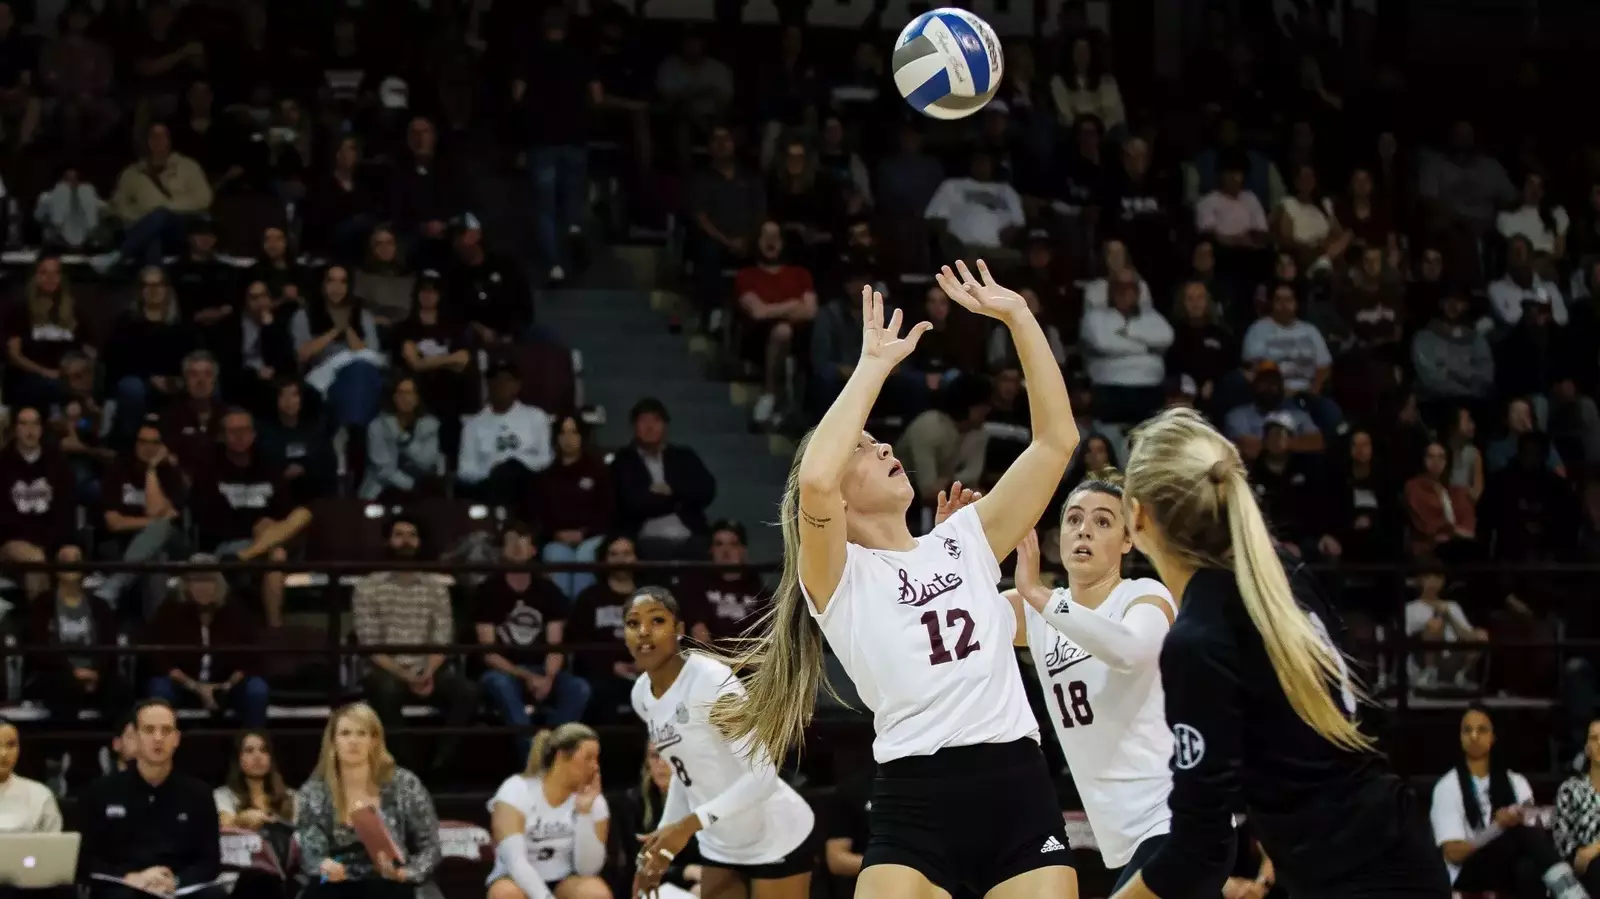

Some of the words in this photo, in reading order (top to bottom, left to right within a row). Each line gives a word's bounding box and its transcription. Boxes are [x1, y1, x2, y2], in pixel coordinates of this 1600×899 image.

[920, 608, 980, 665] 12
[1045, 635, 1090, 673] Sta
[1053, 680, 1094, 728] 18
[670, 756, 692, 787] 8
[1040, 844, 1066, 853] adidas
